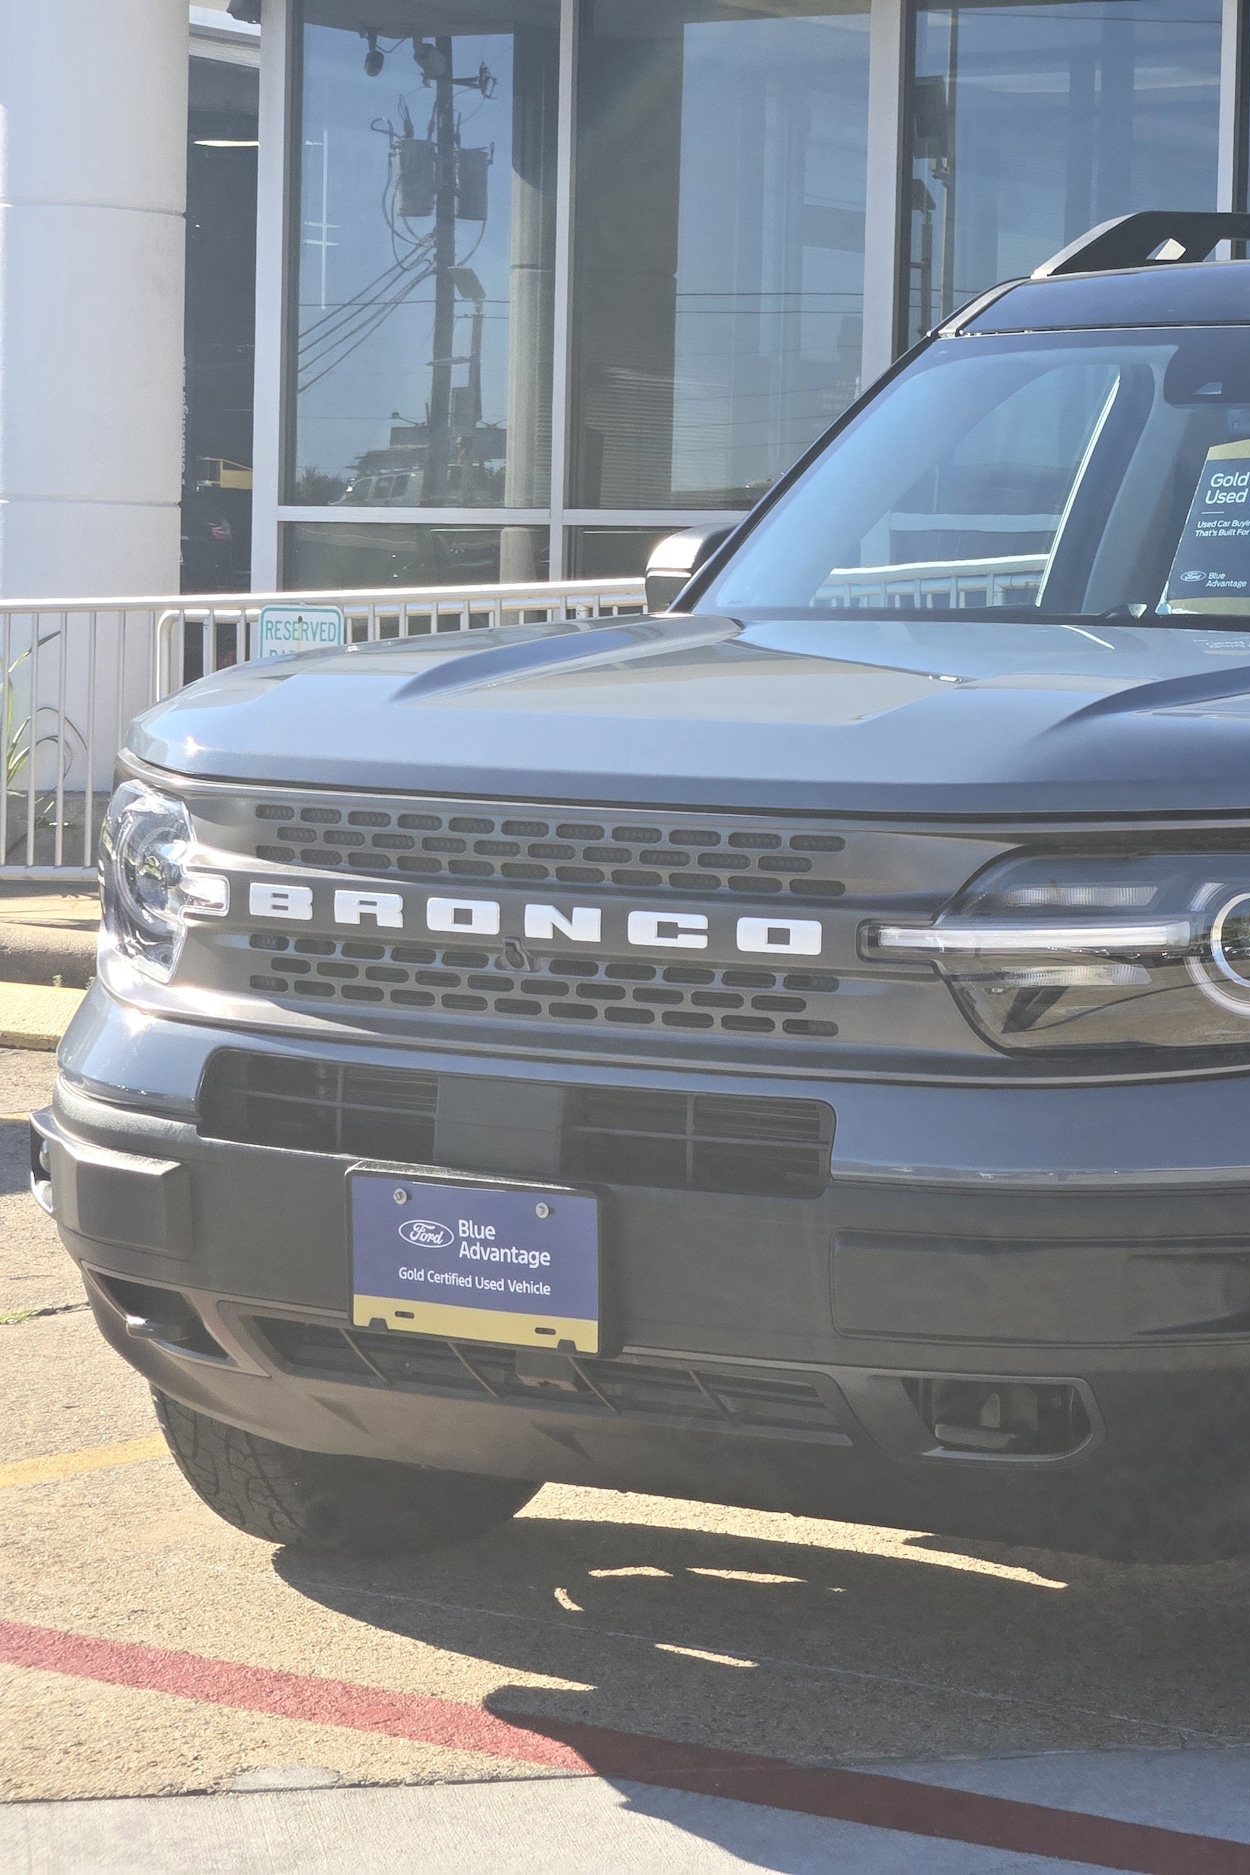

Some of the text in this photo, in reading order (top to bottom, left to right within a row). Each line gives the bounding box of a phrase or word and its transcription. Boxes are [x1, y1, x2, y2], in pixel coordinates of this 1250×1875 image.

[1210, 471, 1250, 488] Gold
[1205, 488, 1249, 504] Used
[1195, 529, 1217, 537] That's
[1218, 528, 1236, 537] Built
[1236, 528, 1250, 536] For
[1197, 520, 1217, 528] Used
[1217, 520, 1231, 528] Car
[1205, 580, 1247, 588] Advantage
[1208, 572, 1226, 580] Blue
[265, 620, 337, 642] RESERVED
[249, 881, 822, 956] BRONCO
[408, 1219, 496, 1246] Ford Blue
[459, 1241, 551, 1269] Advantage
[398, 1266, 551, 1297] Gold Certified Used Vehicle
